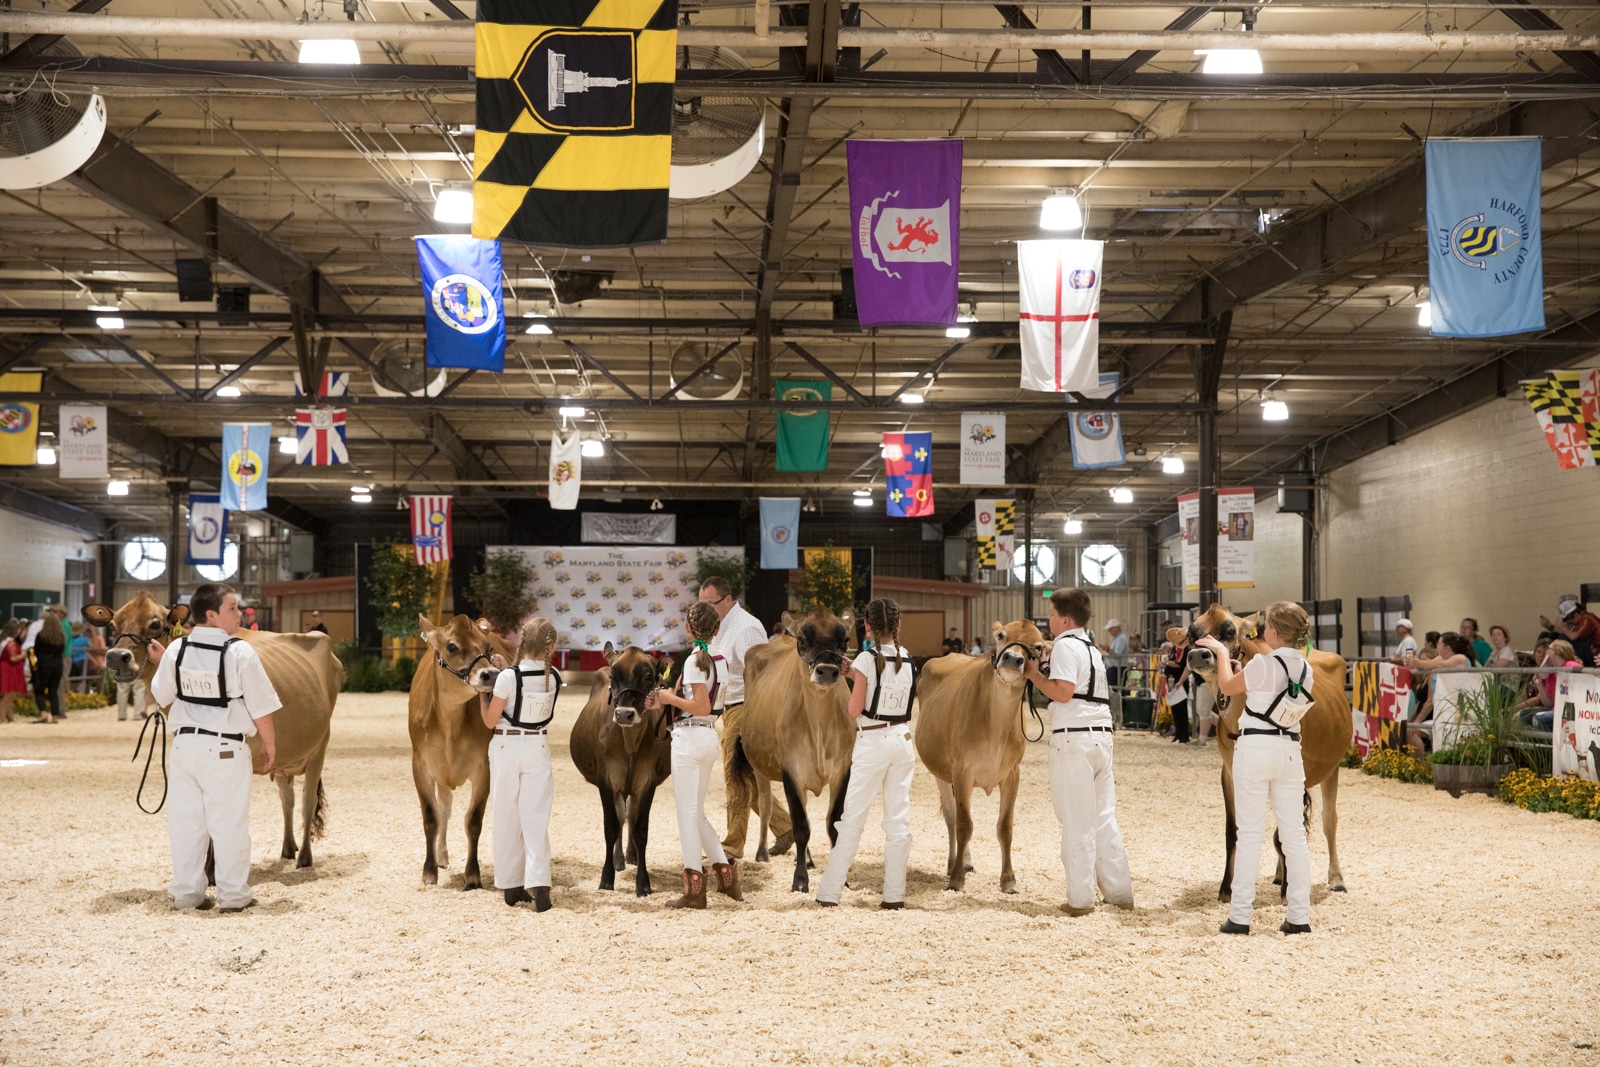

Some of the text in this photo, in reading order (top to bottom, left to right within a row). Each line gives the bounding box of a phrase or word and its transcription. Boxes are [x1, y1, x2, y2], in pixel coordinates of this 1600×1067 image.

[860, 215, 871, 248] Talbot
[1439, 228, 1450, 256] 1773
[1490, 197, 1529, 285] HARFORD COUNTY
